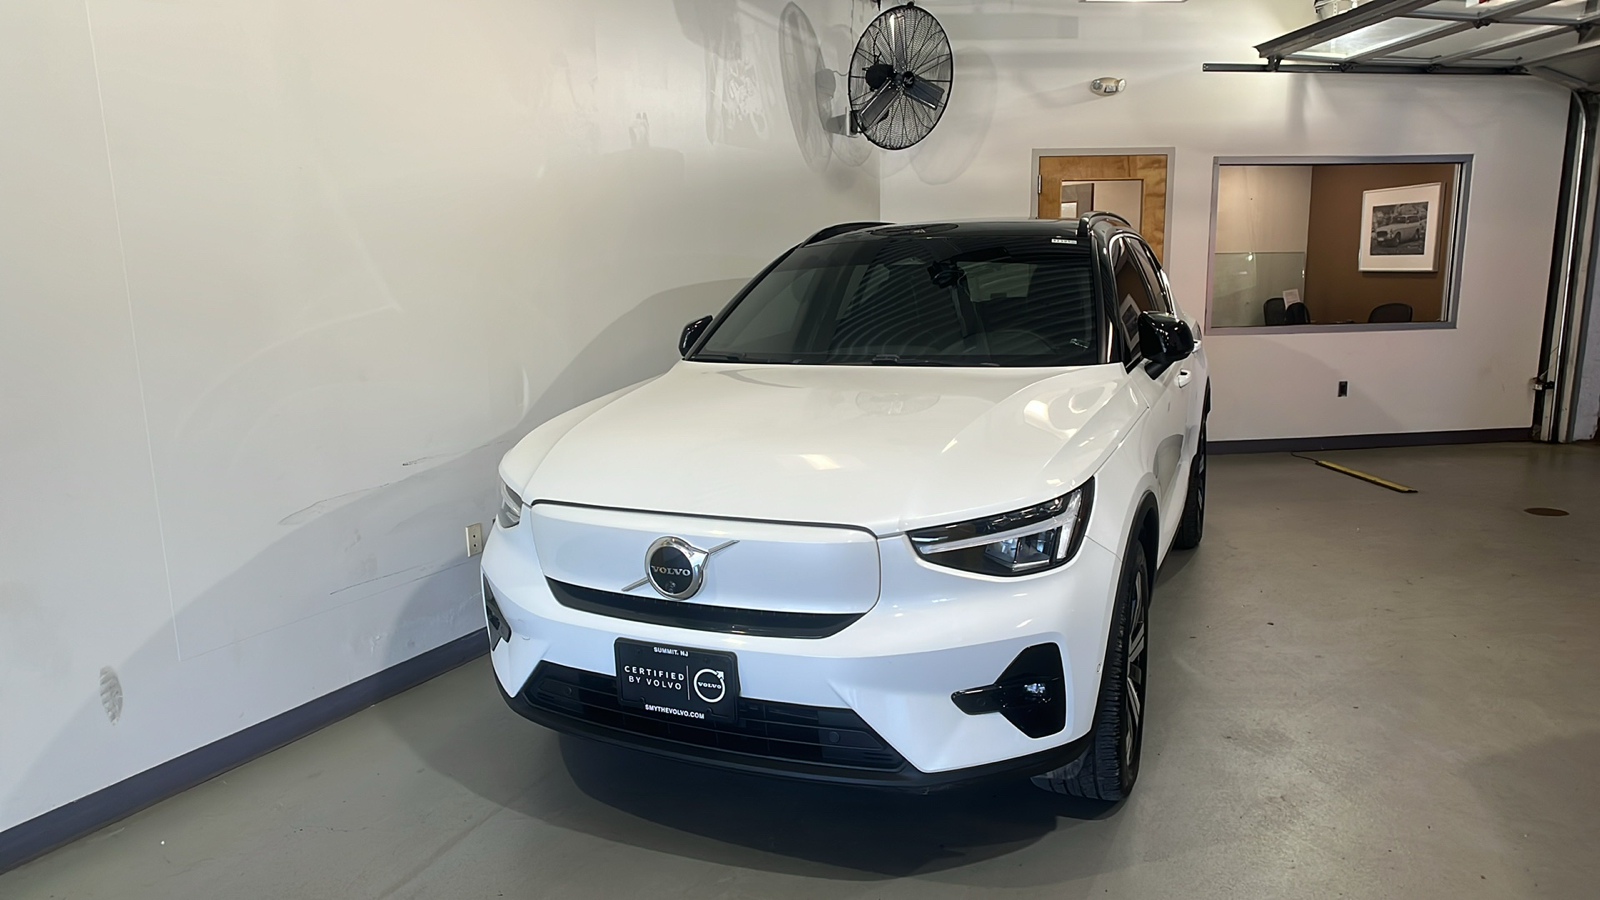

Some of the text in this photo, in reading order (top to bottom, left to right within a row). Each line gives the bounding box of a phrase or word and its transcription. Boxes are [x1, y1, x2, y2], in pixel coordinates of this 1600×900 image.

[651, 565, 691, 577] VOLVO
[624, 665, 685, 681] CERTIFIED
[628, 675, 682, 690] BY VOLVO
[697, 681, 722, 690] VOLVO
[645, 703, 705, 719] SMYTHEVOLVO.COM
